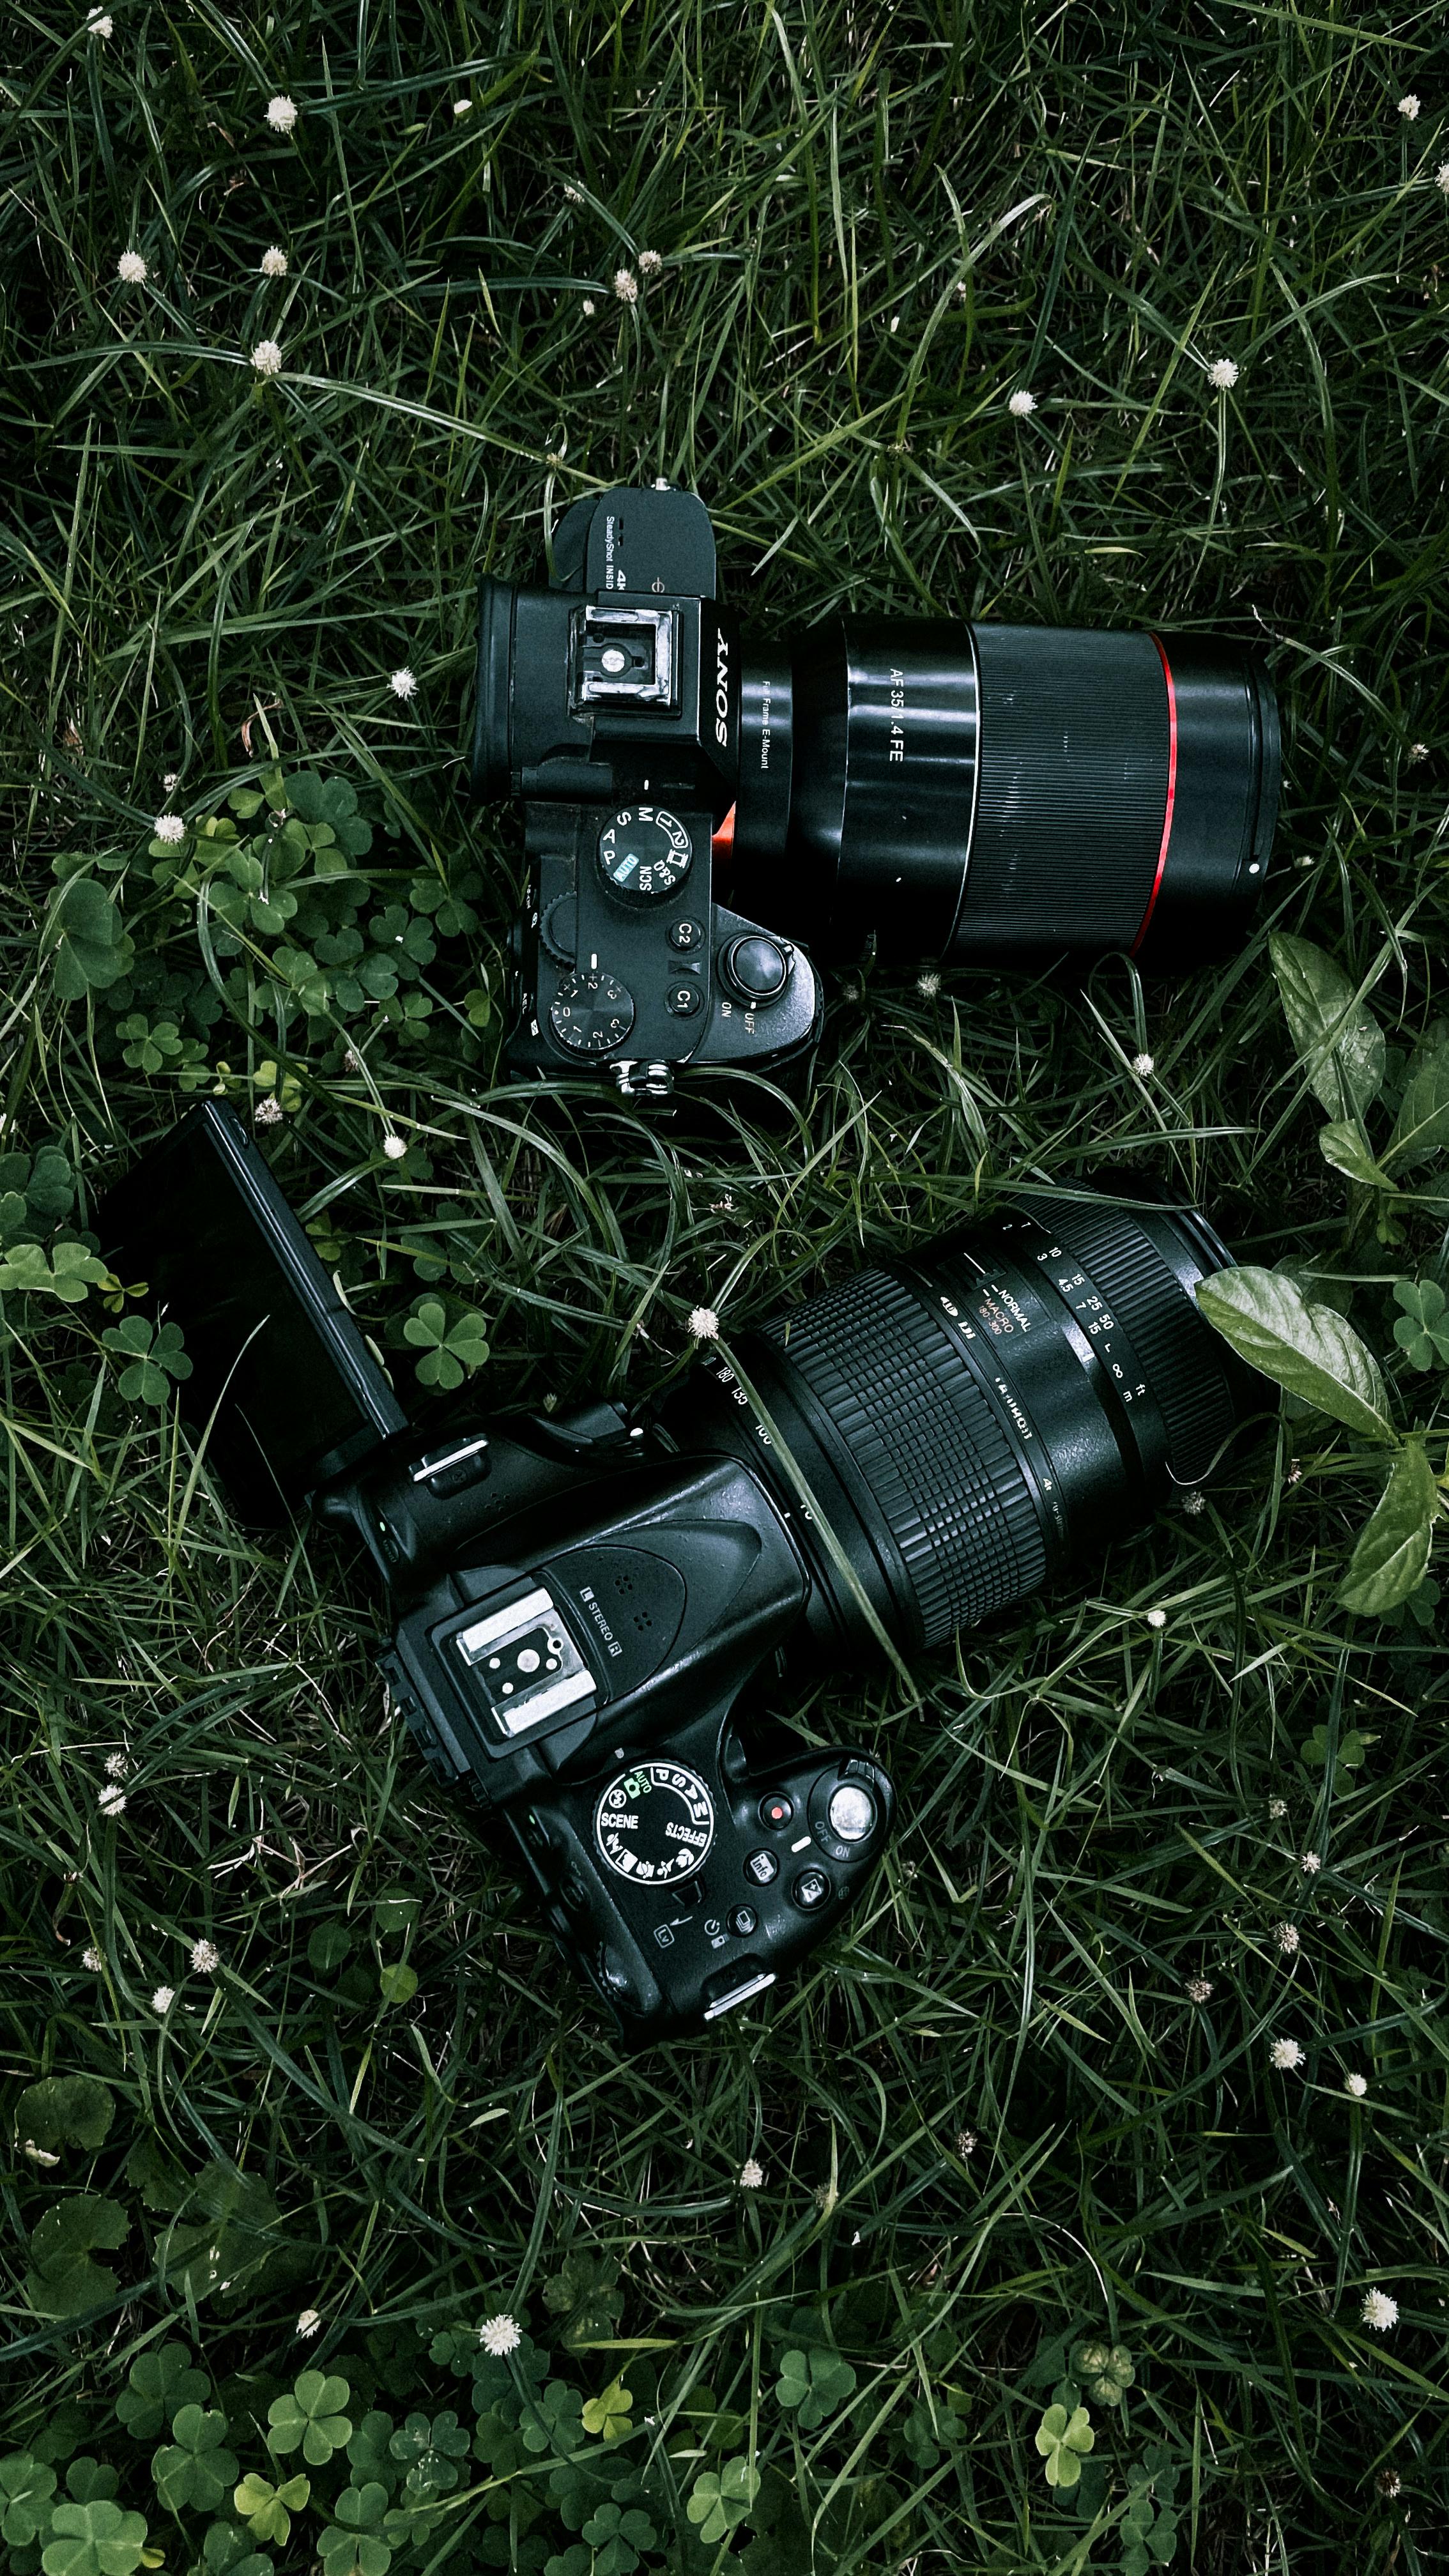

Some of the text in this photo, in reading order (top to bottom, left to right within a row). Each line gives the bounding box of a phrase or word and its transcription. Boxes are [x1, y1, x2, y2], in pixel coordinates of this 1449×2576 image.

[604, 516, 615, 562] SteadyShot
[715, 628, 728, 747] SONY
[761, 681, 770, 769] Full Frame E-Mount
[890, 669, 903, 762] AF 35/1.4 FE
[617, 811, 632, 826] S
[639, 807, 654, 822] M
[602, 829, 615, 844] A
[604, 850, 615, 865] P
[615, 855, 638, 881] AUTO
[640, 866, 652, 891] SCN
[654, 860, 676, 885] S&Q
[678, 924, 691, 946] C2
[677, 990, 690, 1008] C1
[721, 1002, 732, 1017] ON
[744, 1013, 756, 1035] OFF
[979, 1305, 1002, 1336] 180-300
[985, 1298, 1015, 1334] MACRO
[998, 1289, 1031, 1332] NORMAL
[1048, 1246, 1062, 1257] 10
[1071, 1273, 1085, 1285] 15
[1087, 1296, 1103, 1311] 25
[1099, 1314, 1114, 1330] 50
[1135, 1384, 1146, 1396] ft
[1037, 1253, 1048, 1261] 3
[1058, 1278, 1074, 1292] 4.5
[1076, 1301, 1086, 1310] 7
[1088, 1321, 1102, 1335] 15
[1123, 1390, 1133, 1402] m
[716, 1367, 735, 1383] 180
[732, 1387, 749, 1405] 135
[588, 1602, 613, 1641] STEREO
[634, 1770, 652, 1793] AUTO
[655, 1768, 669, 1781] P
[672, 1773, 686, 1788] S
[684, 1784, 698, 1800] A
[600, 1813, 639, 1829] SCENE
[692, 1802, 709, 1817] M
[666, 1821, 707, 1848] EFFECTS
[815, 1821, 832, 1843] OFF
[834, 1846, 850, 1858] ON
[751, 1855, 770, 1880] info
